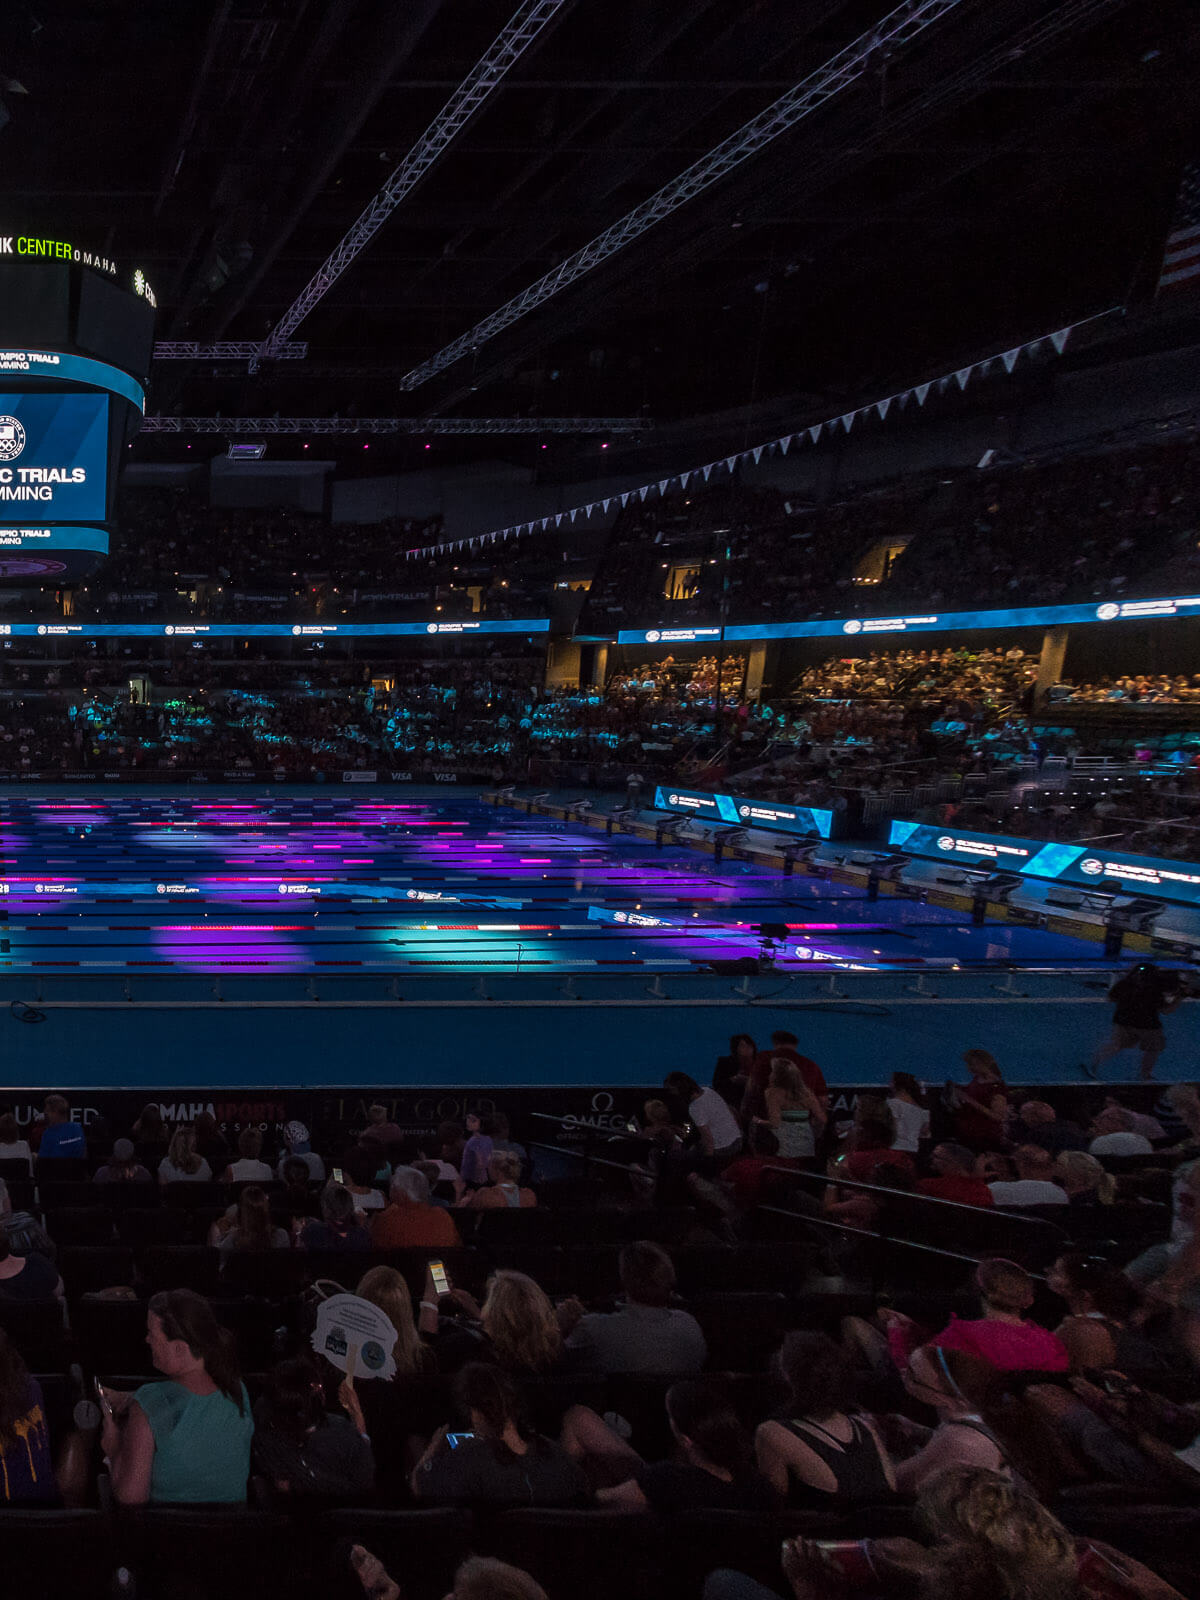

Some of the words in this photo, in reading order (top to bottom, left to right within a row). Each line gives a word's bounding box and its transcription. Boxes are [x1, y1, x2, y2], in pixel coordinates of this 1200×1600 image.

[17, 236, 72, 260] CENTER
[74, 249, 117, 275] OMAHA
[27, 353, 60, 364] TRIALS
[17, 467, 86, 483] TRIALS
[391, 772, 412, 780] VISA
[433, 773, 456, 782] VISA
